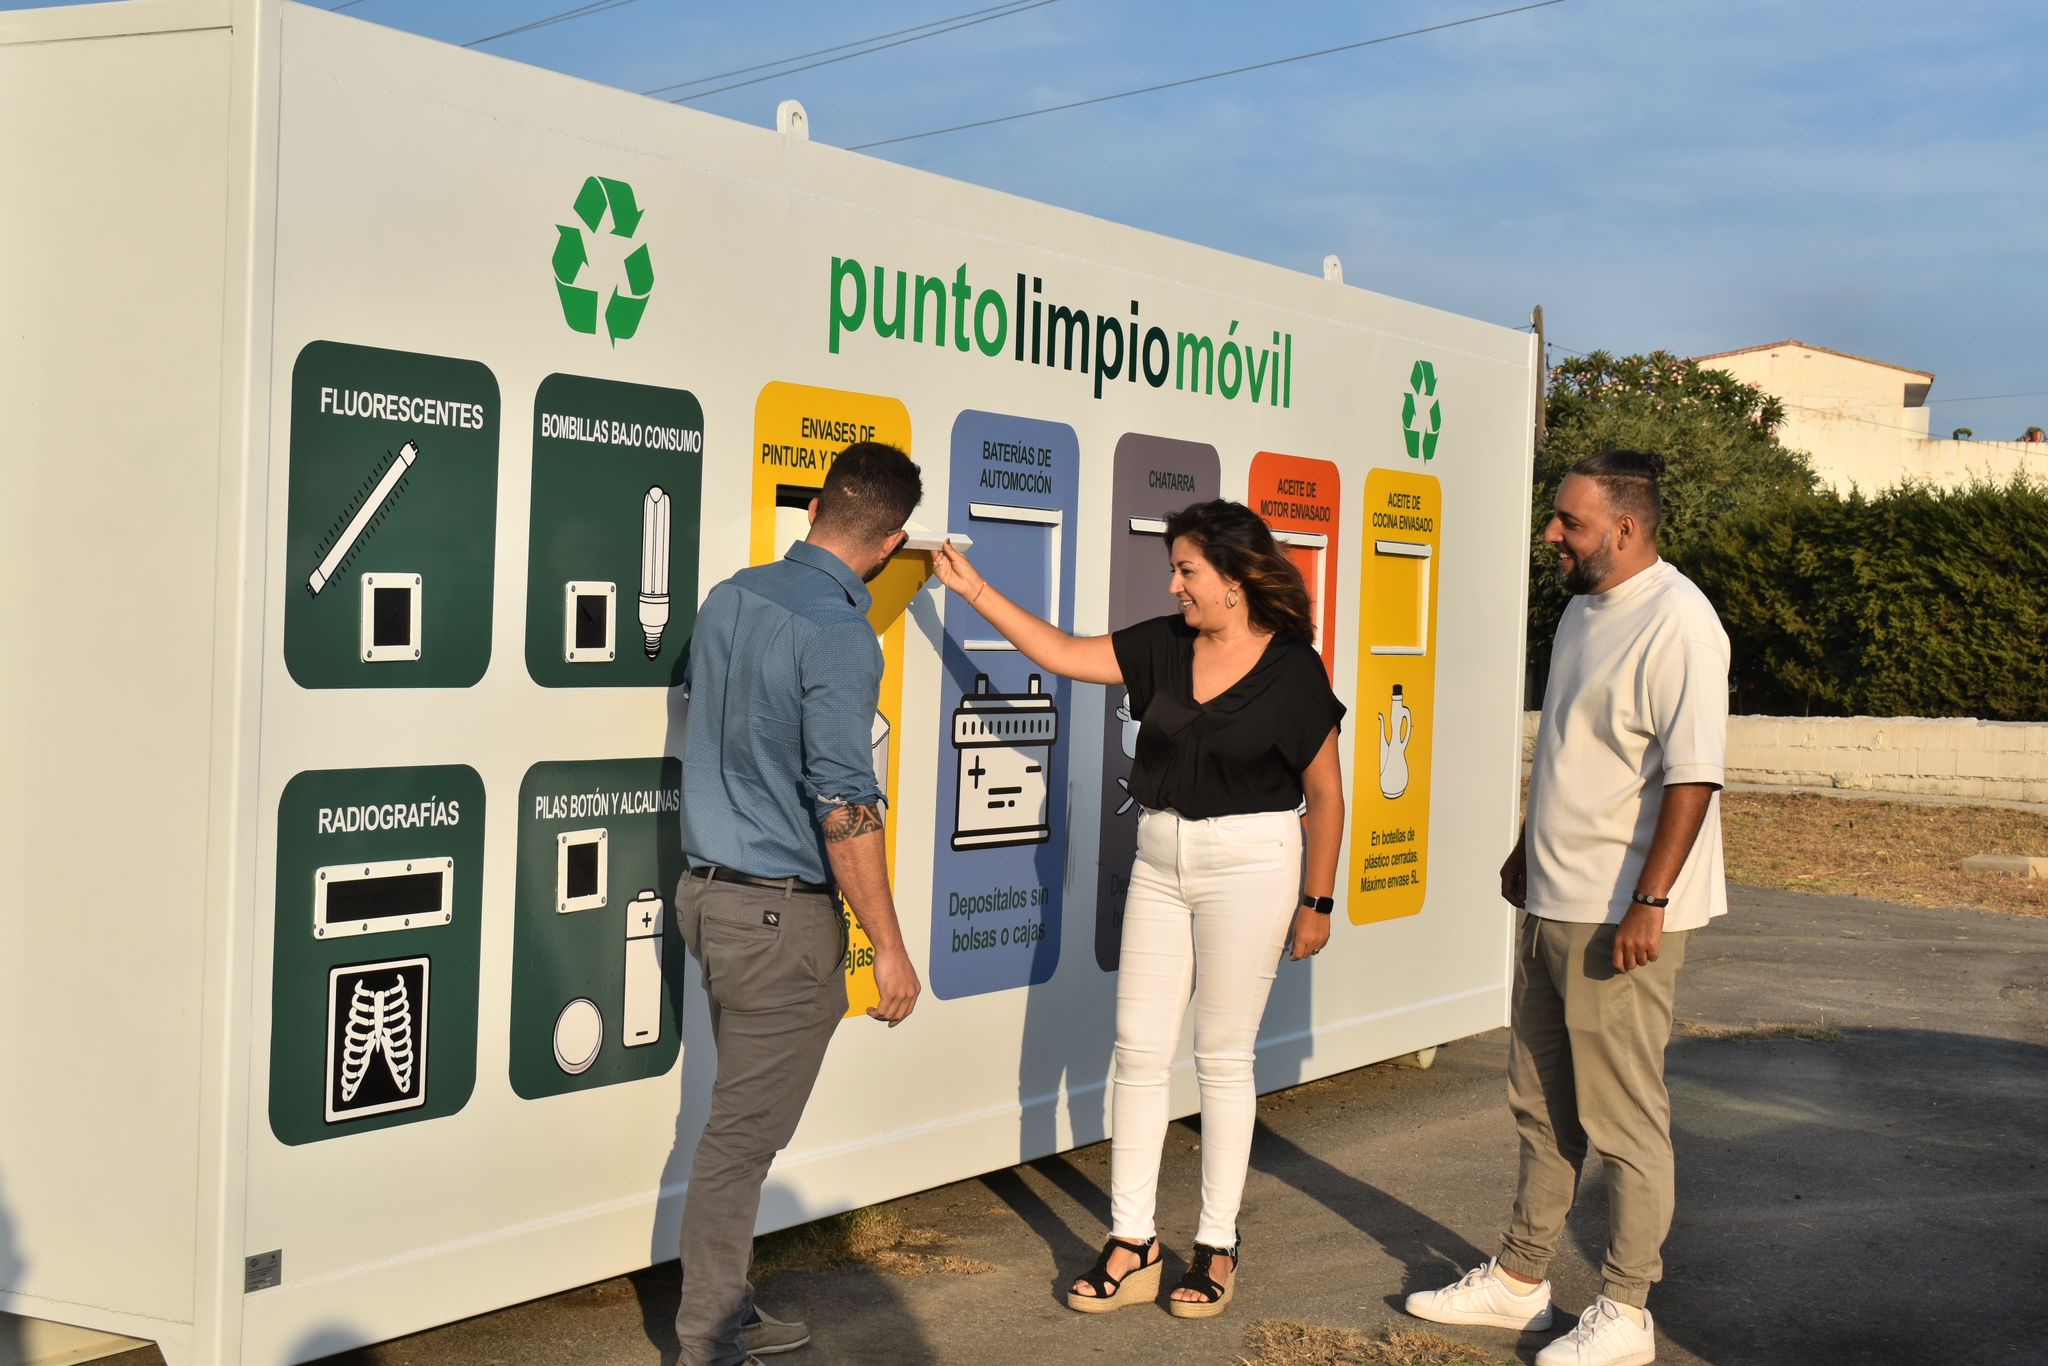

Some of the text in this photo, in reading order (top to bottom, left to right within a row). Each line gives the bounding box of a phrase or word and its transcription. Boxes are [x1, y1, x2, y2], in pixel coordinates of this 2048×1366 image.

[320, 386, 484, 430] FLUORESCENTES
[541, 413, 701, 453] BOMBILLAS BAJO CONSUMO
[801, 417, 857, 443] ENVASES
[762, 443, 817, 470] PINTURA
[819, 450, 828, 470] Y
[982, 440, 1052, 468] BATERÍAS DE
[980, 468, 1052, 494] AUTOMOCIÓN
[1149, 469, 1196, 493] CHATARRA
[1277, 478, 1317, 498] ACEITE DE
[1260, 499, 1331, 522] MOTOR ENVASADO
[1387, 492, 1421, 510] ACEITE DE
[1372, 512, 1433, 533] COCINA ENVASADO
[318, 795, 460, 834] RADIOGRAFÍAS
[535, 787, 680, 820] PILAS BOTÓN Y ALCALINAS
[1371, 826, 1415, 847] En botellas de
[1364, 852, 1390, 874] plástico
[1360, 875, 1387, 893] Máximo
[1387, 874, 1410, 889] envase
[949, 881, 1049, 921] Deposítalos sin
[952, 918, 1045, 953] bolsas o cajas
[845, 942, 874, 976] ajas
